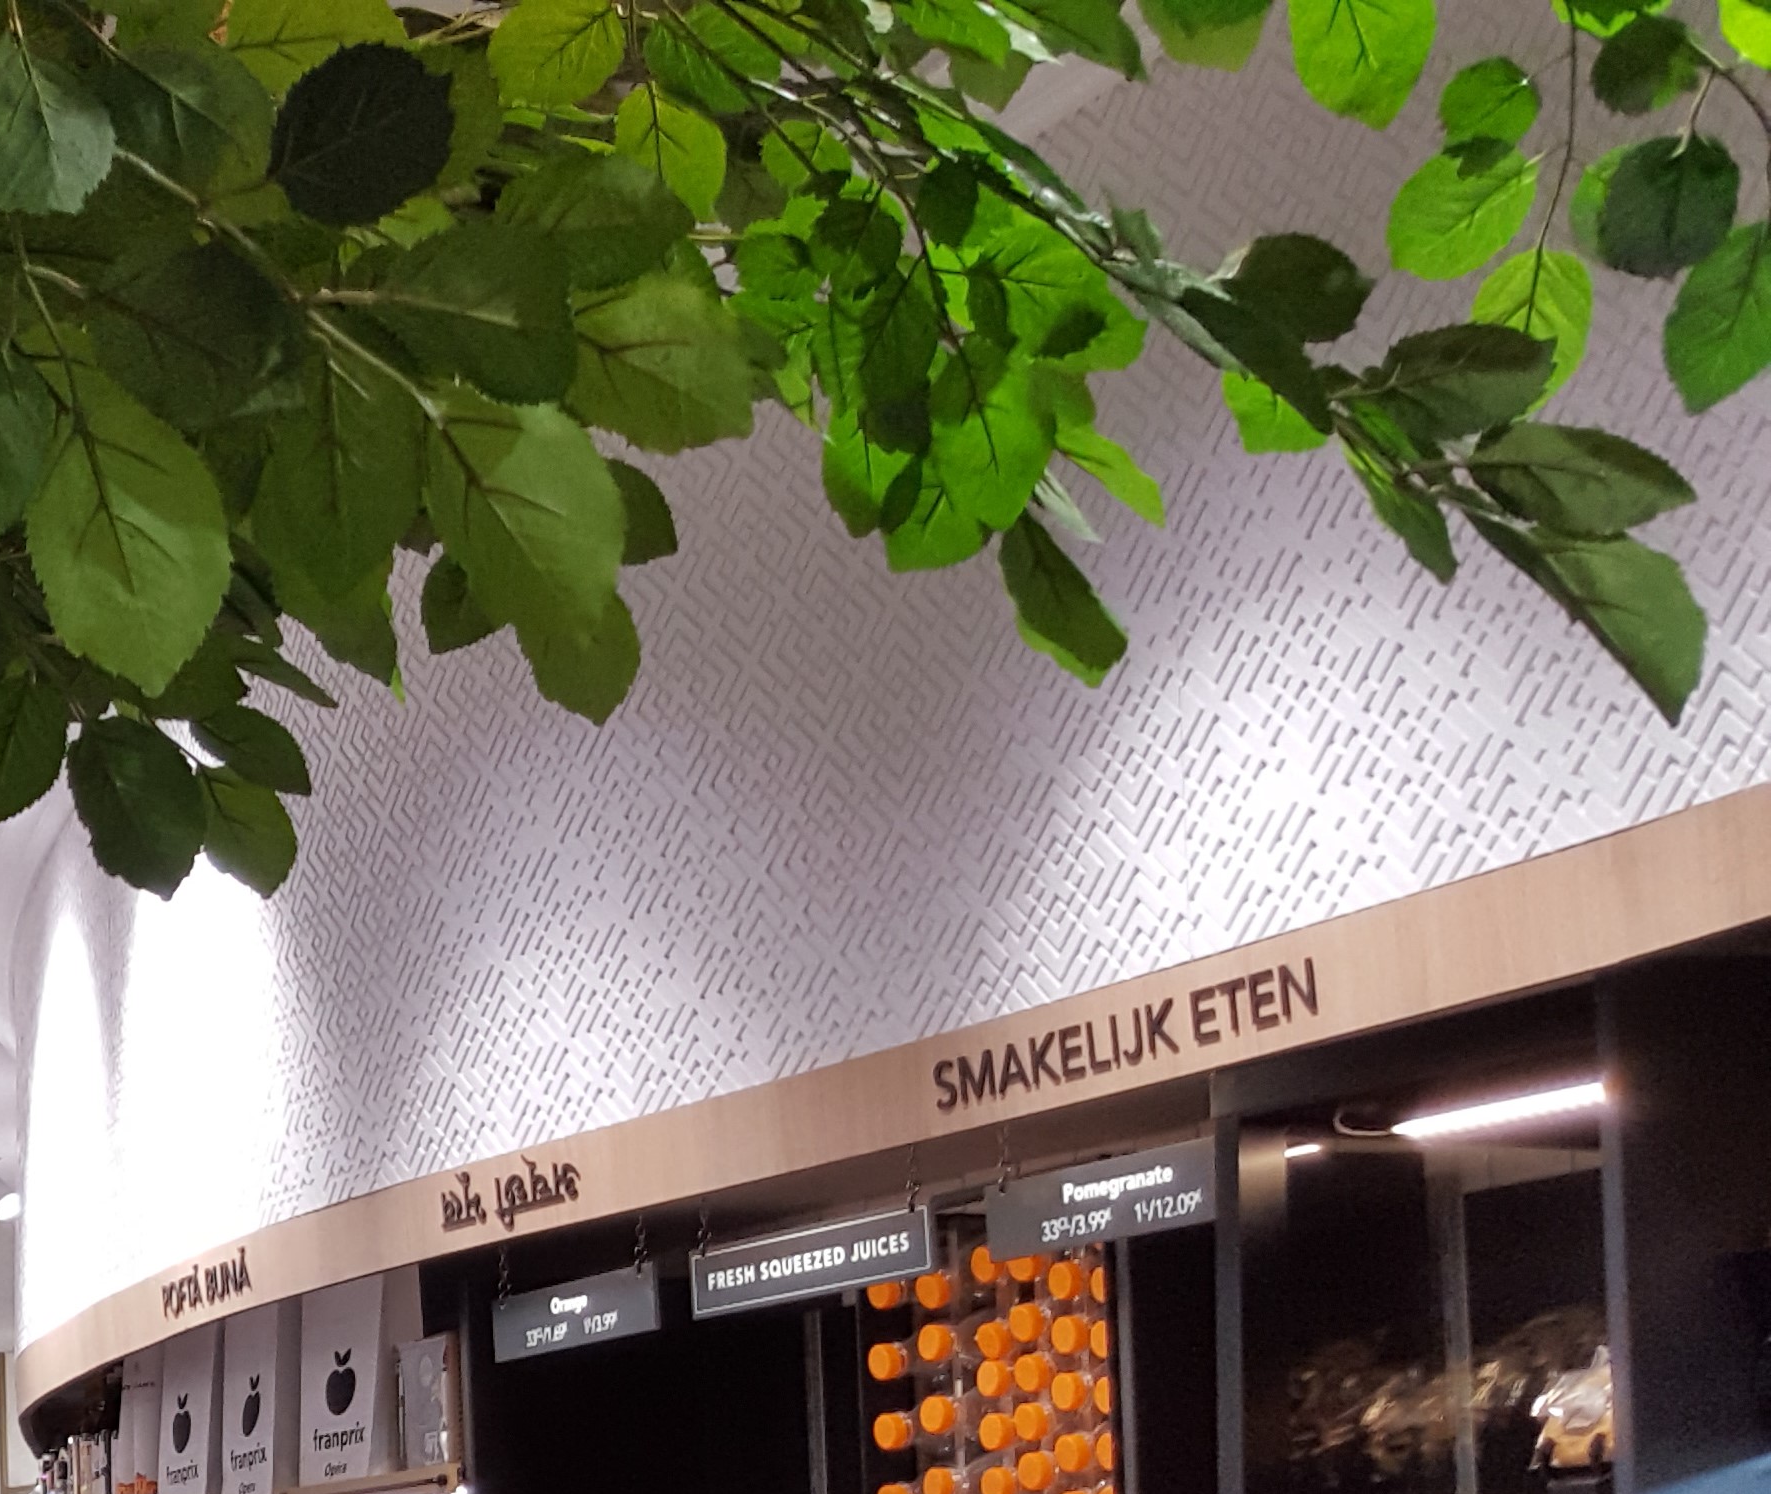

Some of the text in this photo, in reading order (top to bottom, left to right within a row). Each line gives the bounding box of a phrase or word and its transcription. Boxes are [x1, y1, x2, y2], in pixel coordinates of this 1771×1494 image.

[933, 956, 1319, 1110] SMAKELIJK ETEN
[1062, 1165, 1173, 1204] Pomegranate
[708, 1231, 909, 1291] FRESH SQUEEZED JUICES
[313, 1422, 366, 1452] franprix
[230, 1442, 268, 1472] franprix
